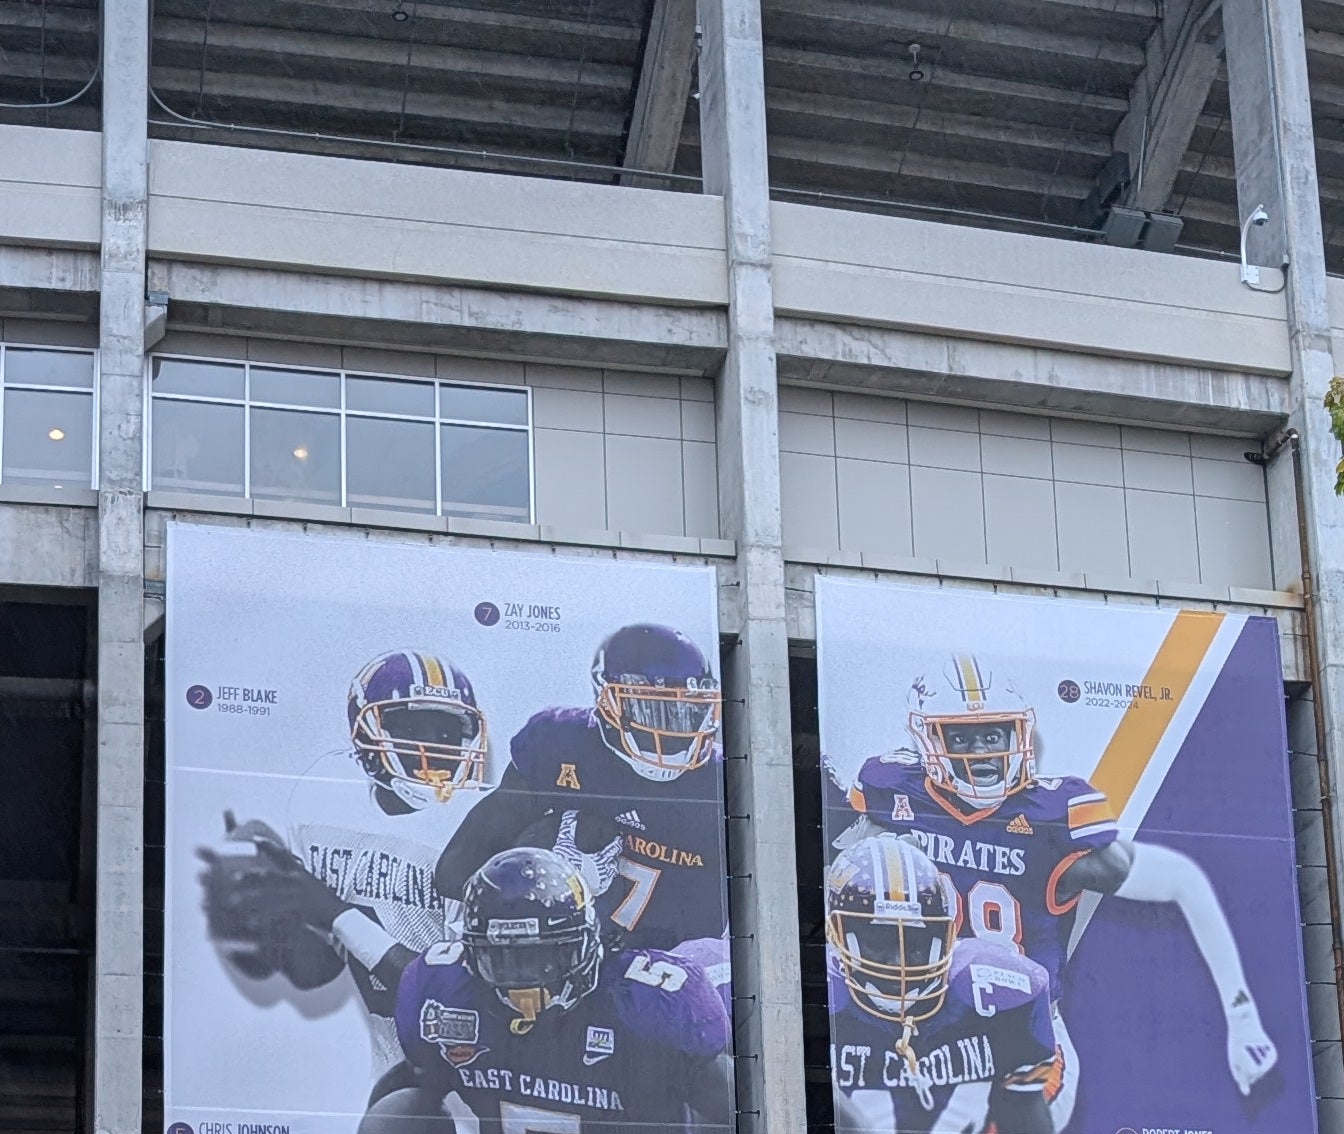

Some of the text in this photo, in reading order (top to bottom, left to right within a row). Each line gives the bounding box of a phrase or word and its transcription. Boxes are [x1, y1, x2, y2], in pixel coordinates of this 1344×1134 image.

[504, 602, 524, 618] ZAY
[527, 604, 561, 620] JONES
[505, 619, 561, 633] 2013-2016
[216, 686, 240, 701] JEFF
[242, 688, 278, 704] BLAKE
[1083, 680, 1123, 697] SHAVON
[1125, 684, 1157, 701] REVEL,
[1159, 687, 1174, 700] JR.
[217, 703, 271, 716] 1988-1991
[1085, 697, 1139, 710] 2022-2024
[624, 834, 704, 867] AROLINA
[910, 829, 1026, 876] PIRATES
[458, 1068, 624, 1111] EAST CAROLINA
